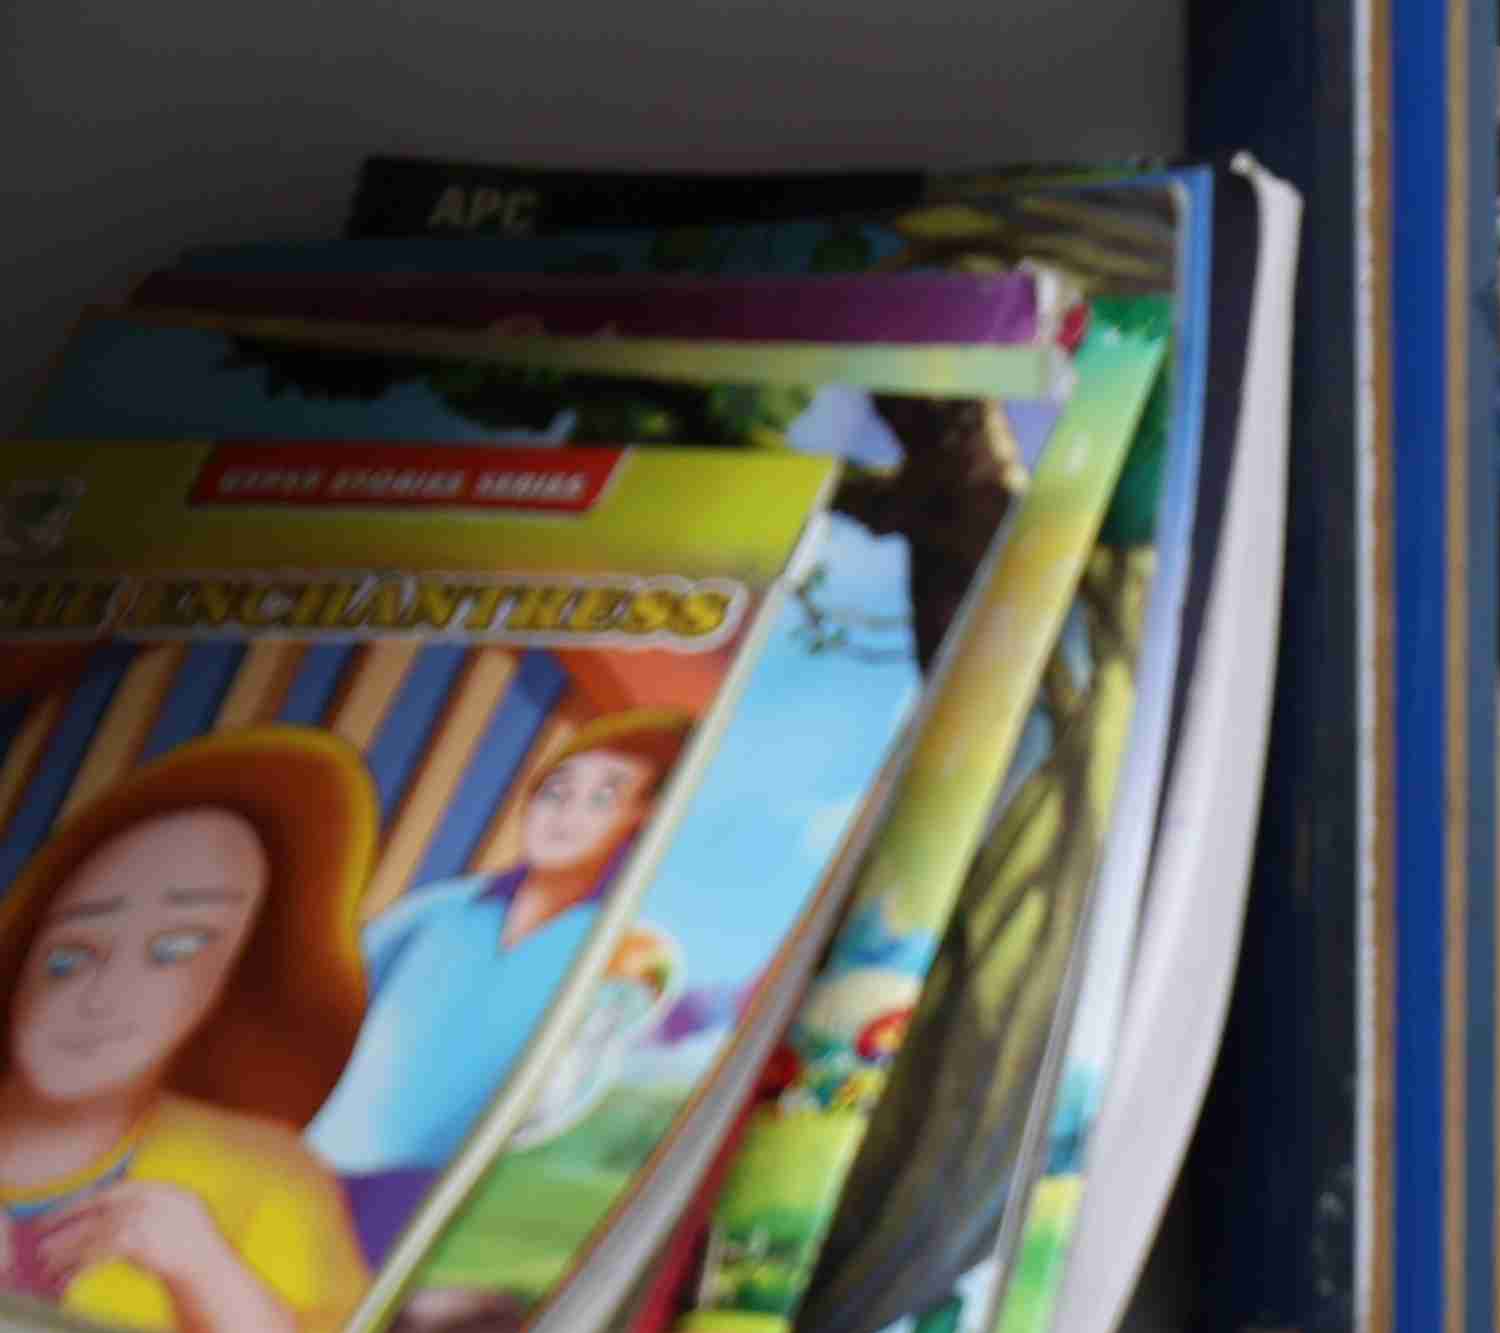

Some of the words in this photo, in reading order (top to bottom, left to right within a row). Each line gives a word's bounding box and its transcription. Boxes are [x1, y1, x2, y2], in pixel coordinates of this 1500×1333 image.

[428, 184, 539, 228] APC
[472, 470, 589, 501] SERIES
[132, 574, 730, 636] ENCHANTRESS
